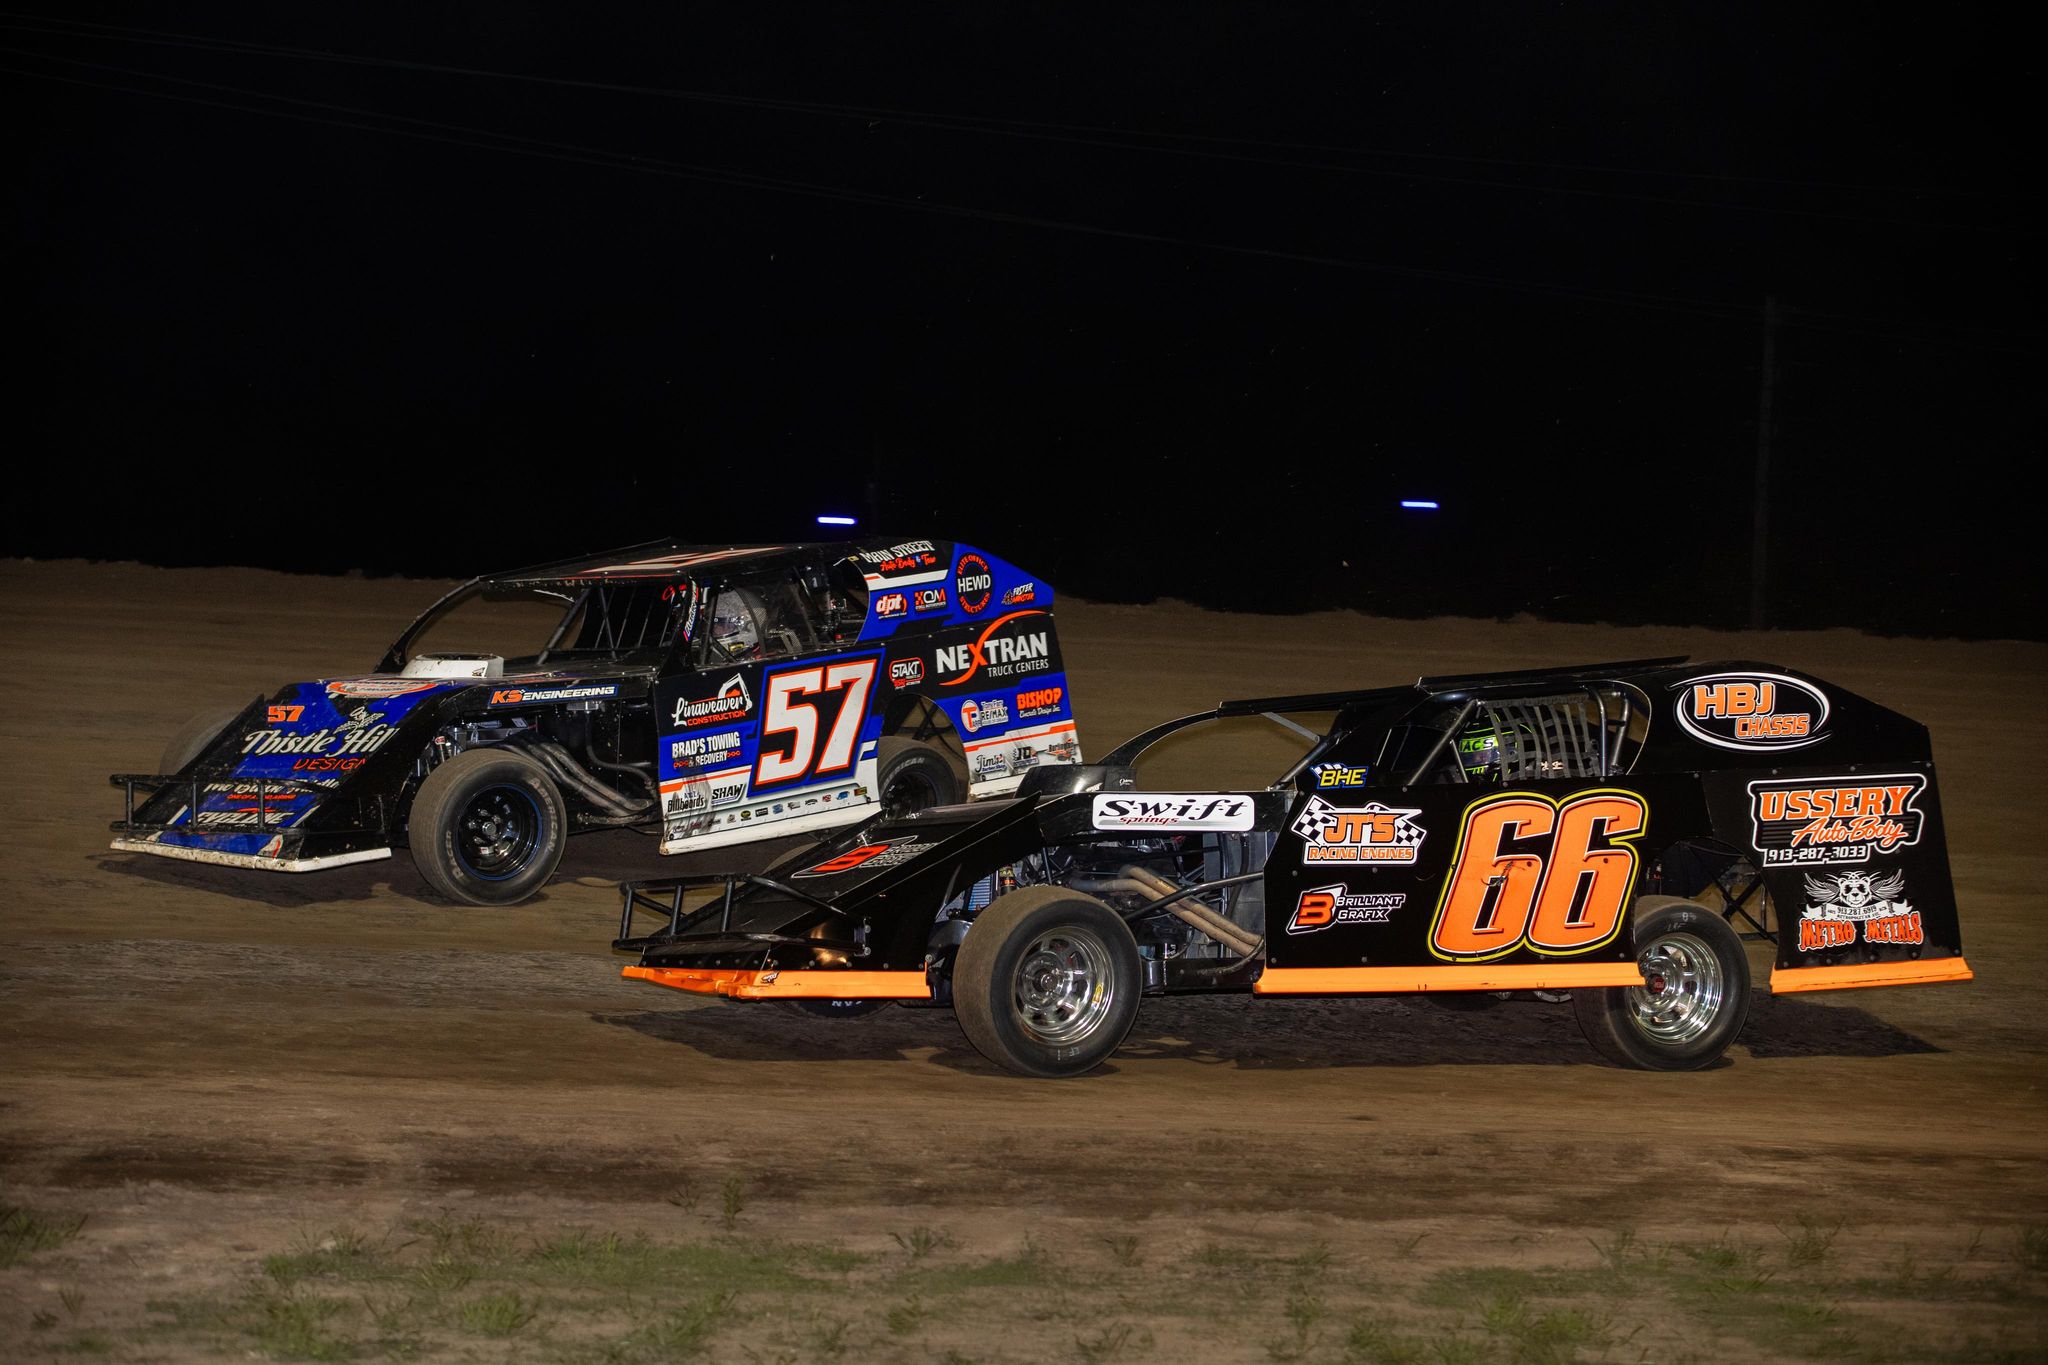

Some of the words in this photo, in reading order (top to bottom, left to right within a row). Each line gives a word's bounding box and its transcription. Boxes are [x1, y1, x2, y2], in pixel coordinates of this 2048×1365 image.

[859, 549, 895, 563] MAIN
[889, 540, 936, 558] STREET
[957, 574, 991, 593] HEWD
[936, 632, 1049, 674] NEXTRAN
[987, 664, 1014, 678] TRUCK
[1015, 658, 1049, 674] CENTERS
[522, 685, 615, 702] ENGINEERING
[1016, 688, 1063, 711] BISHOP
[1694, 683, 1776, 719] HBJ
[267, 705, 306, 723] 57
[687, 709, 746, 727] CONSTRUCTION
[755, 659, 877, 785] 57
[1735, 714, 1810, 738] CHASSIS
[241, 728, 336, 757] Thistle
[672, 736, 706, 759] BRAD'S
[706, 731, 741, 752] TOWING
[695, 750, 729, 767] RECOVERY
[1320, 768, 1367, 787] BHE
[711, 783, 744, 800] SHAW
[1759, 785, 1915, 822] USSERY
[1119, 815, 1180, 826] springs
[1323, 813, 1400, 843] JT'S
[1308, 846, 1359, 861] RACING
[1360, 846, 1414, 860] ENGINES
[1768, 845, 1867, 863] 913-287-3033
[1432, 794, 1644, 956] 66
[1336, 895, 1404, 908] BRILLIANT
[1338, 908, 1386, 921] GRAFIX
[1798, 918, 1857, 952] METRO
[1863, 911, 1924, 945] METALS
